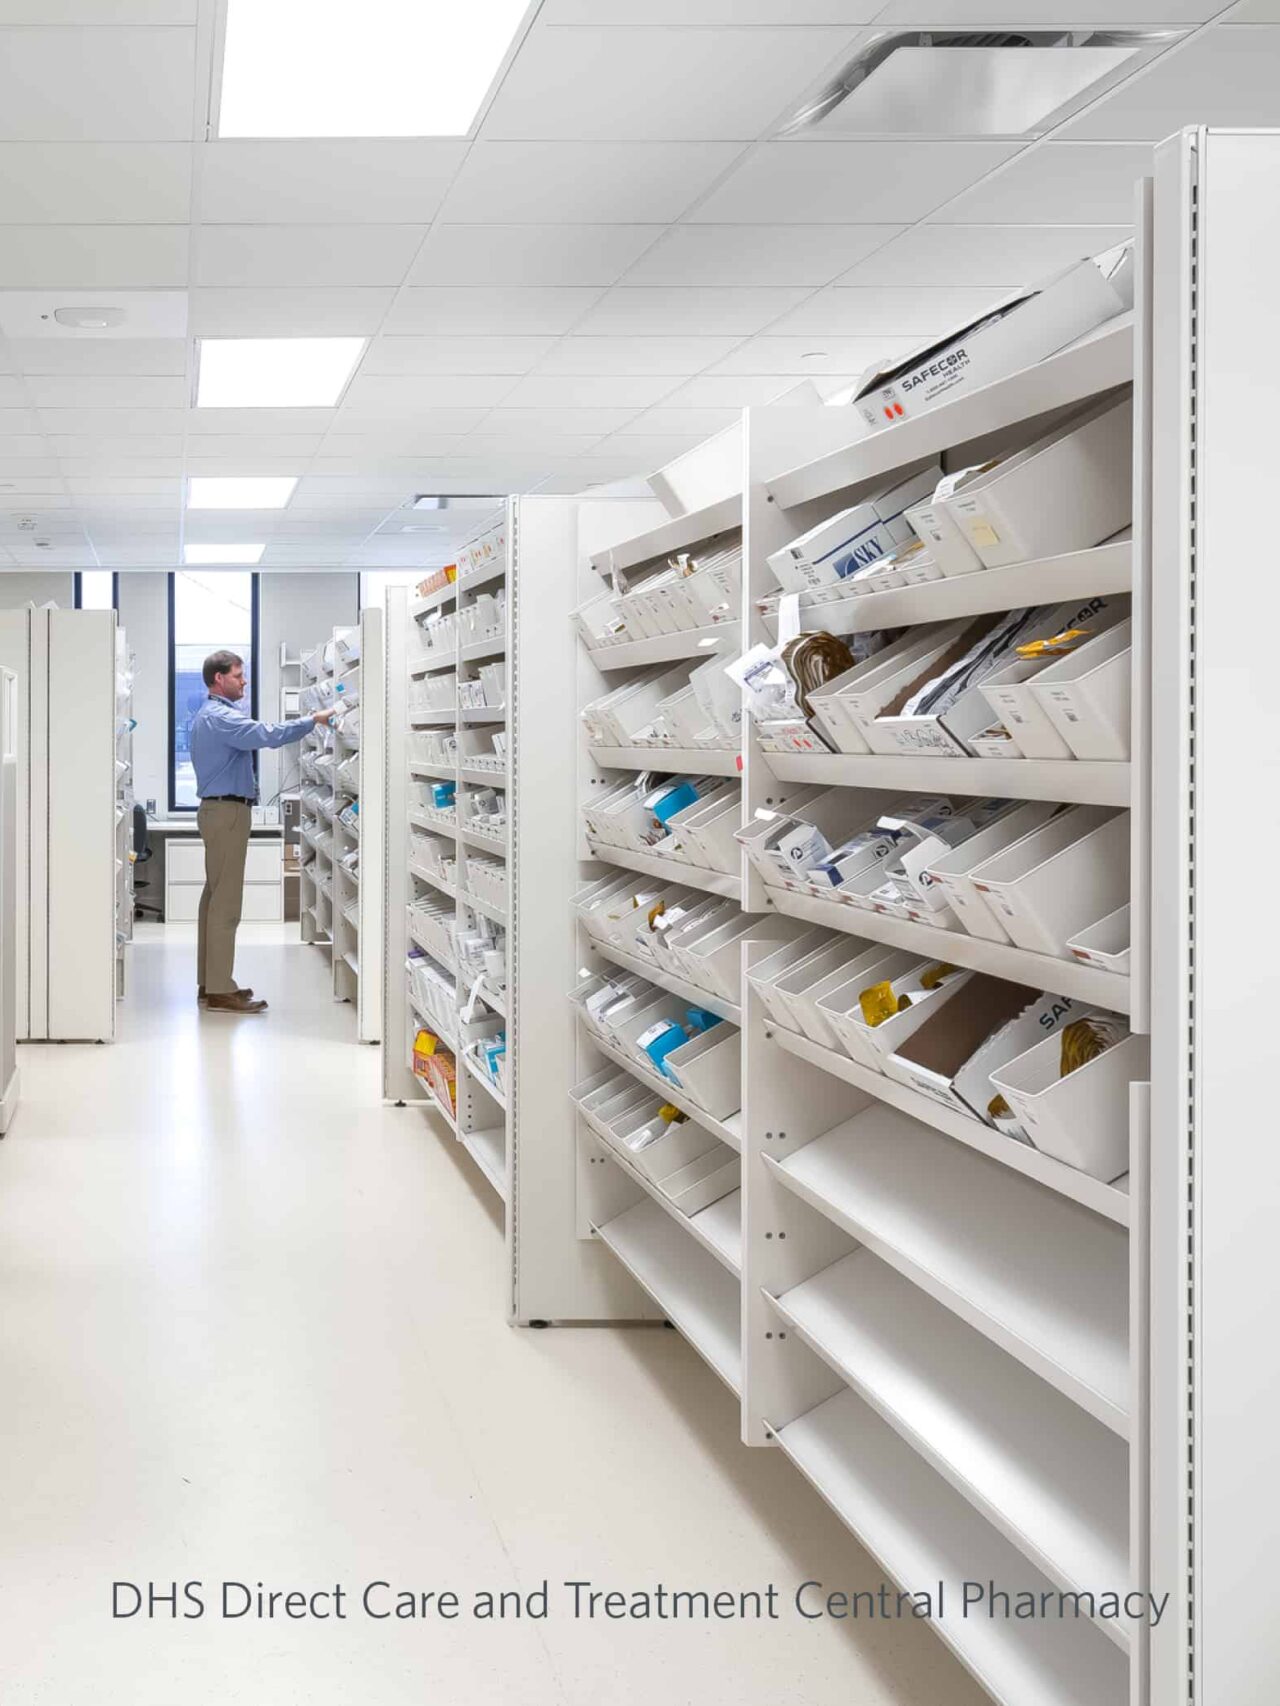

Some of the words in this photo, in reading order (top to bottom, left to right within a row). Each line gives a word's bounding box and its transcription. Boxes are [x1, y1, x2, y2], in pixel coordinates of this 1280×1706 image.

[901, 348, 969, 393] SAFECOR
[942, 359, 971, 379] HEALTH
[852, 536, 885, 567] SKY
